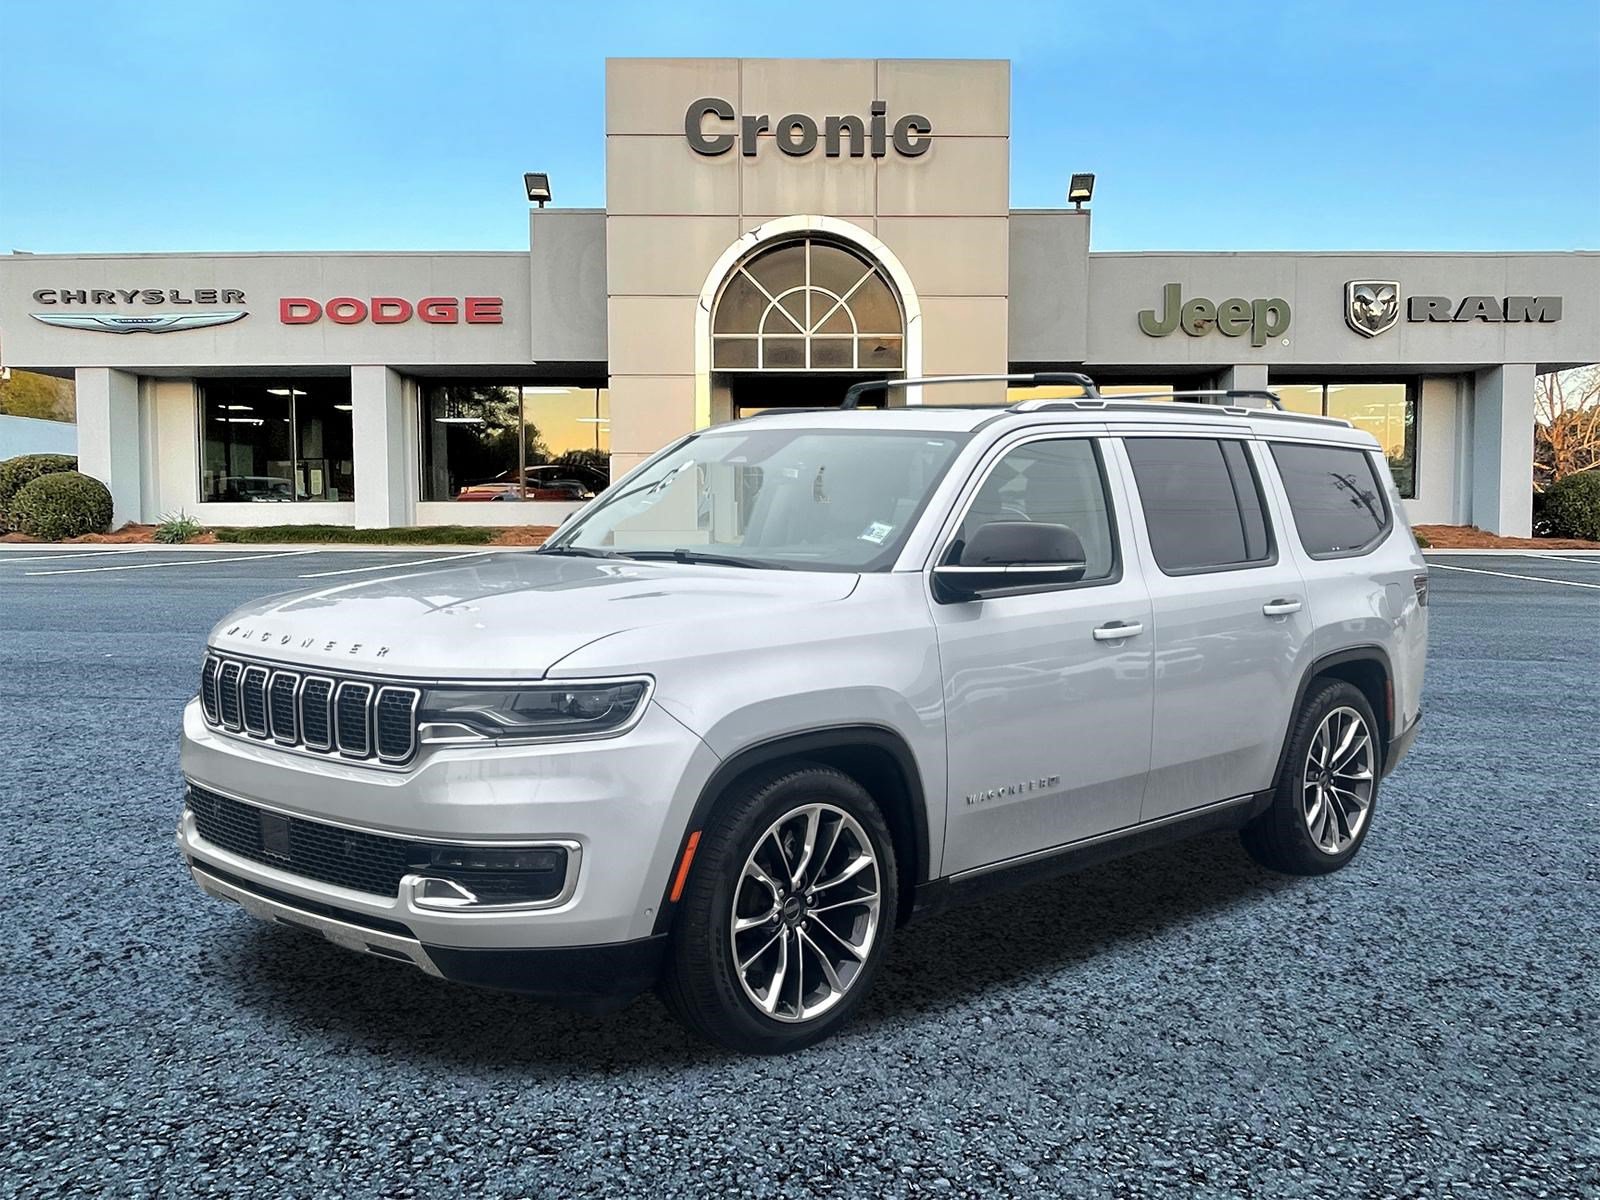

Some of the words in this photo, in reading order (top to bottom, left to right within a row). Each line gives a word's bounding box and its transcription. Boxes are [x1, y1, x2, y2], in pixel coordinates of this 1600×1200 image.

[685, 97, 932, 157] Cronic
[32, 288, 247, 304] CHRYSLER
[1407, 296, 1562, 322] RAM
[280, 297, 503, 324] DODGE
[1138, 283, 1292, 347] Jeep
